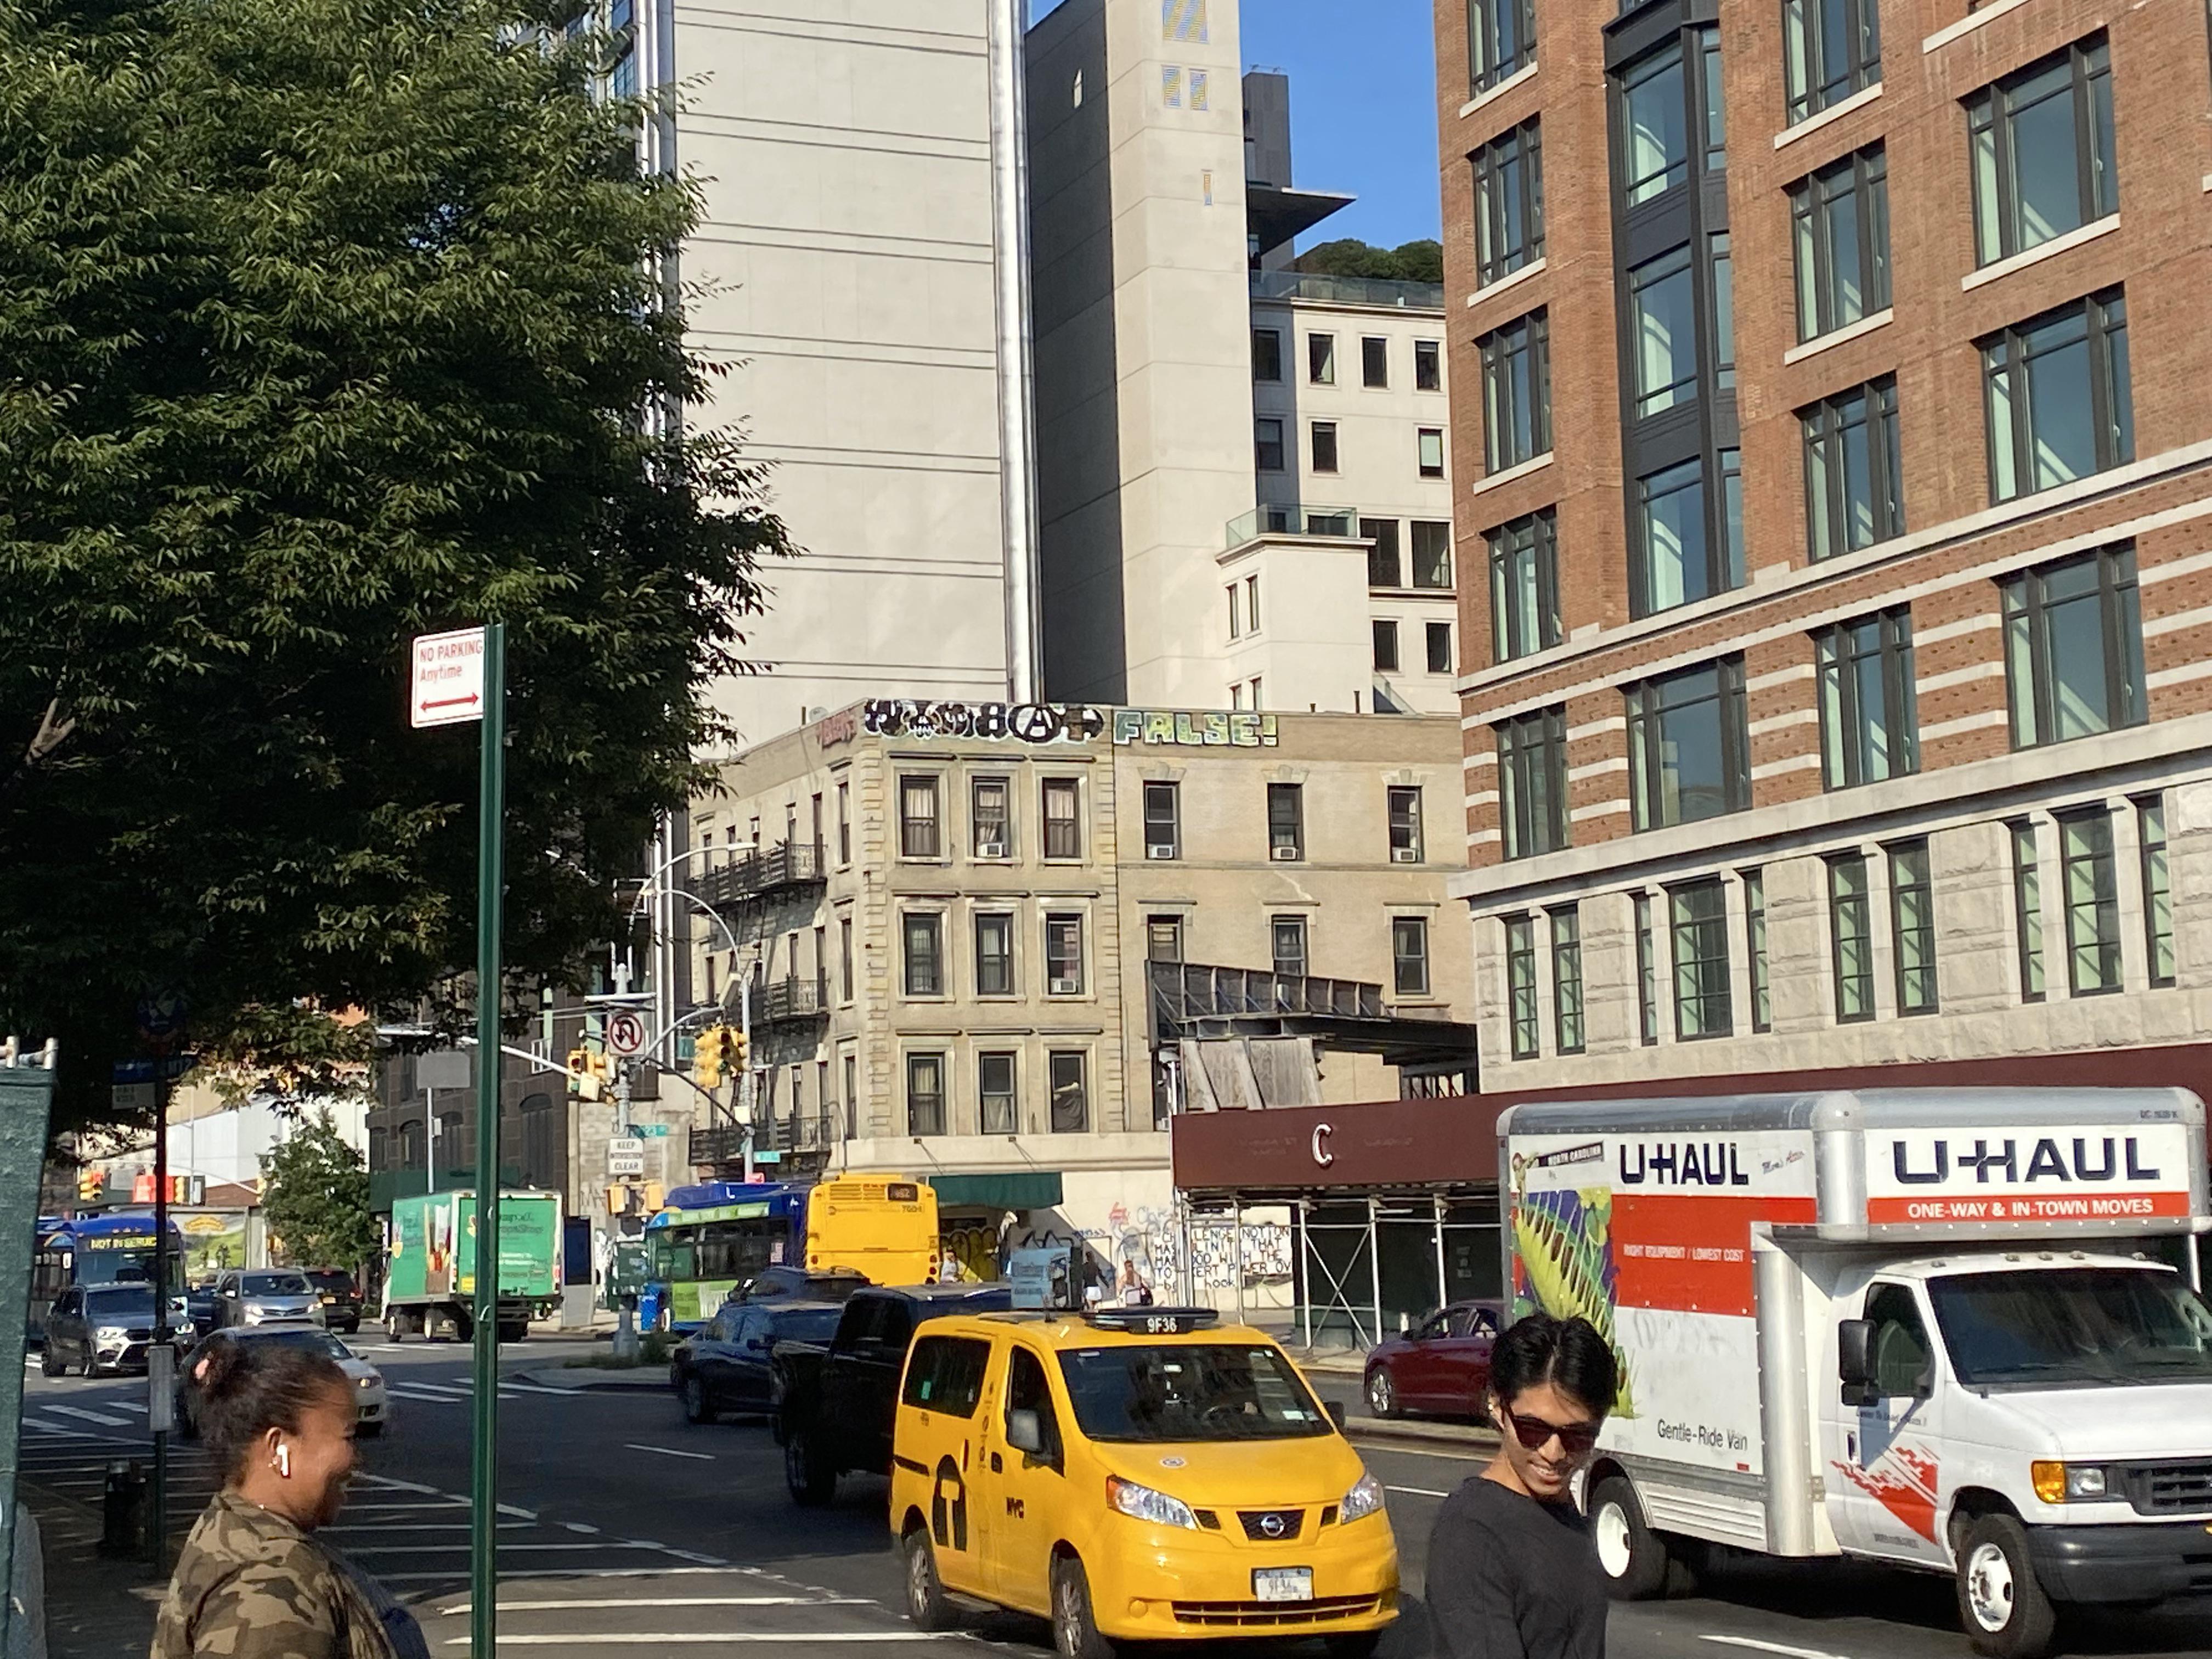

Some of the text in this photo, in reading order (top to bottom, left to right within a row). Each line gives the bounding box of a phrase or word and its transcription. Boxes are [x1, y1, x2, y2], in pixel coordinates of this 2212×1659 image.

[420, 639, 483, 662] NO PARKING
[420, 664, 462, 683] Anytime
[1113, 711, 1278, 747] FALSE!
[617, 1141, 636, 1149] KEEP
[1312, 1123, 1333, 1164] C
[614, 1162, 639, 1171] CLEAR
[1620, 1143, 1749, 1185] U-HAUL
[1892, 1137, 2160, 1184] U-HAUL
[1908, 1198, 2154, 1218] ONE-WAY & IN-TOWN MOVES
[91, 1238, 112, 1250] NOT
[1251, 1237, 1282, 1250] THAT
[1260, 1249, 1283, 1261] THE
[1147, 1317, 1177, 1333] 9F36
[1657, 1418, 1748, 1451] Gentle-Ride Van
[1006, 1496, 1024, 1519] NYC
